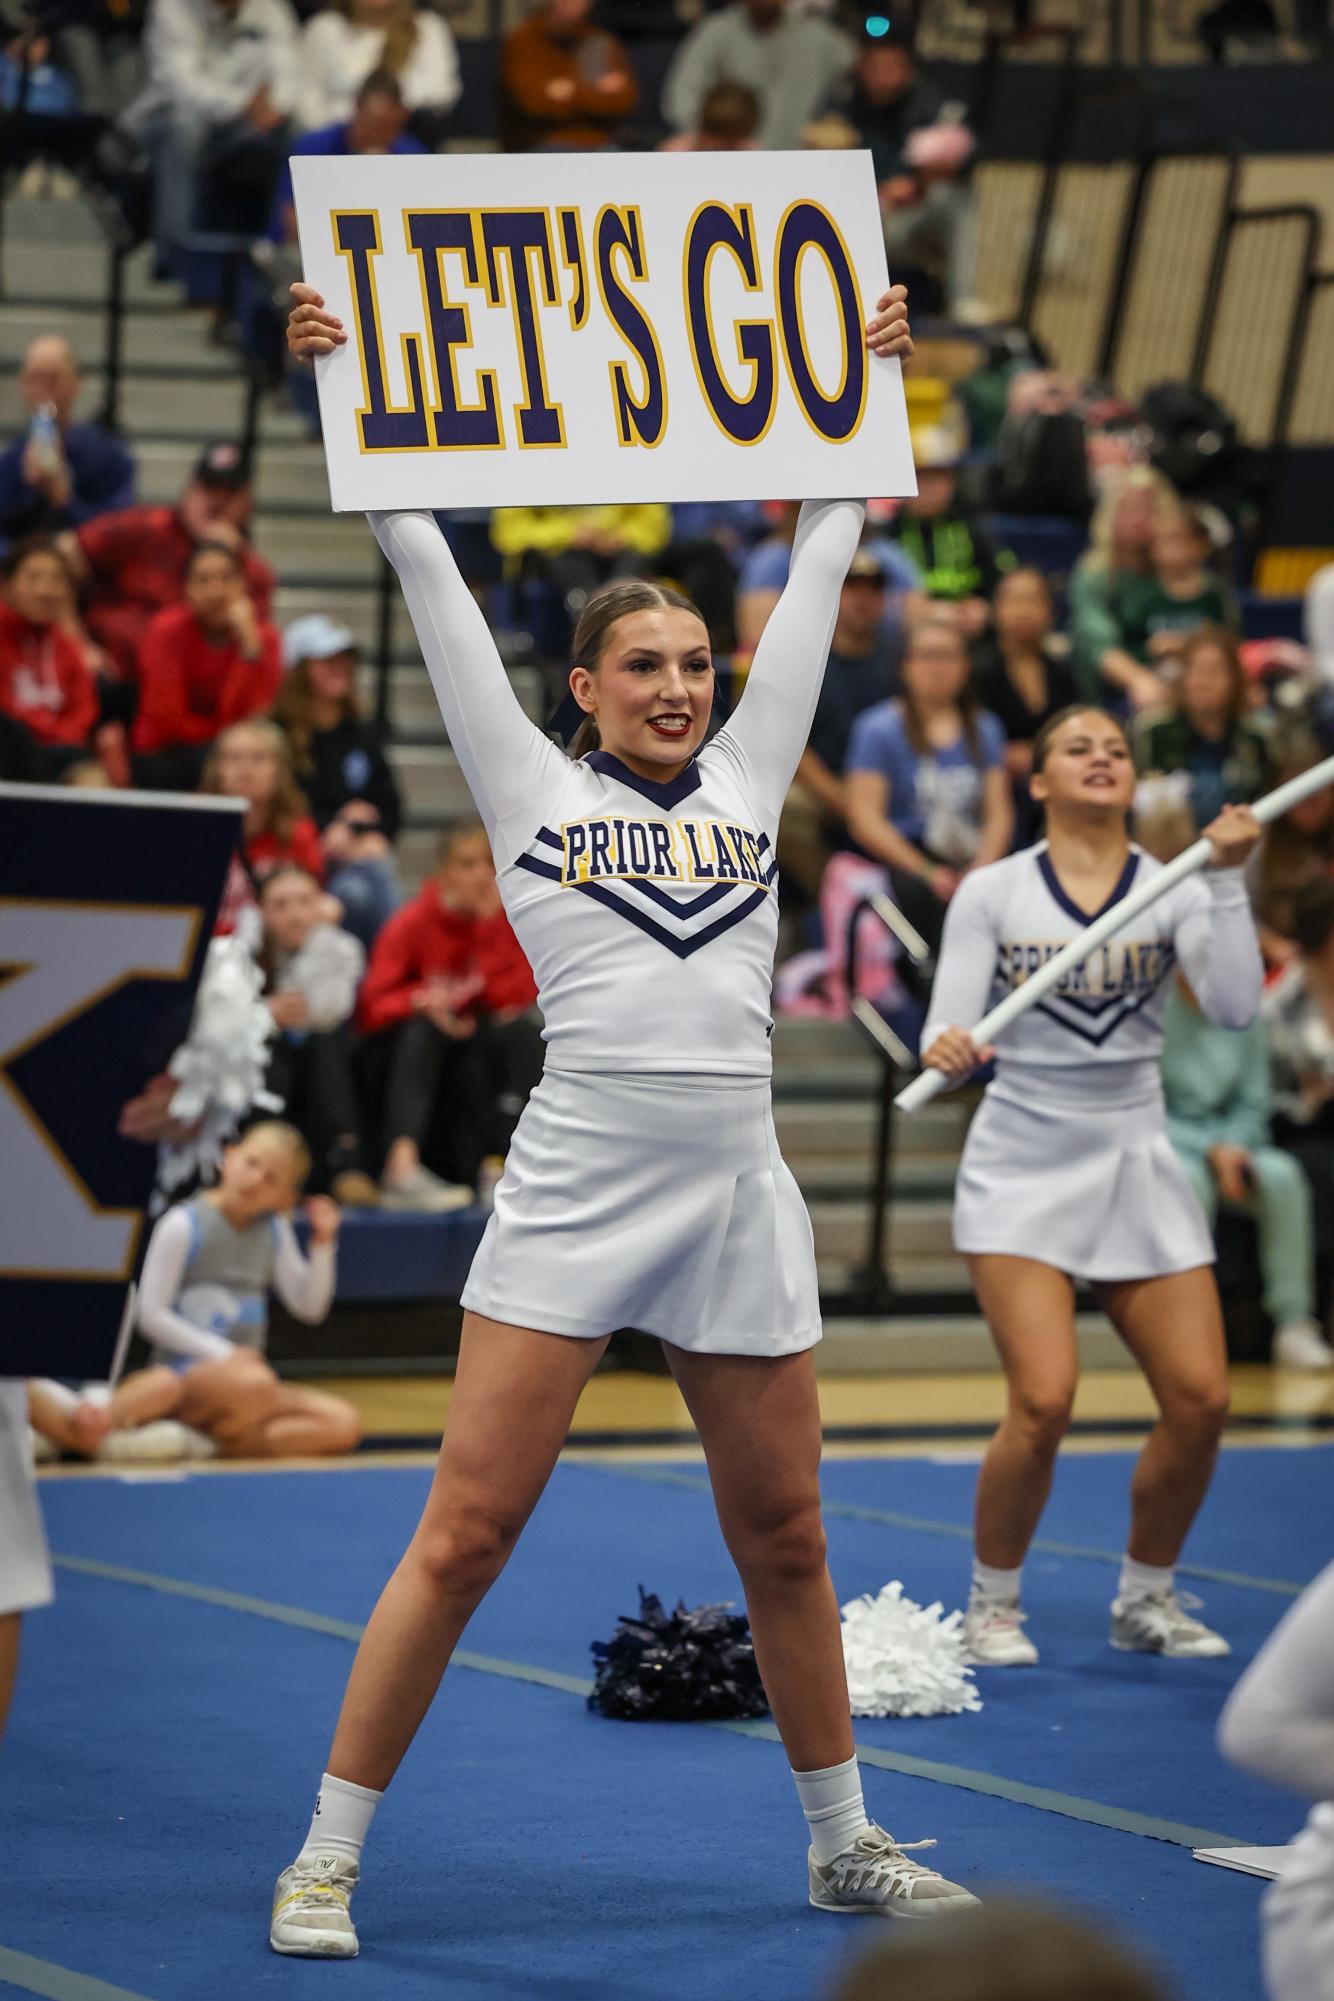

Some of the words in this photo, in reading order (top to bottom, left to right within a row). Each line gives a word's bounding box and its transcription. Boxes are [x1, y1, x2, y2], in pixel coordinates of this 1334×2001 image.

[330, 203, 668, 454] LET'S
[682, 199, 869, 446] GO
[563, 818, 680, 885] PRIOR
[681, 822, 769, 889] LAKE
